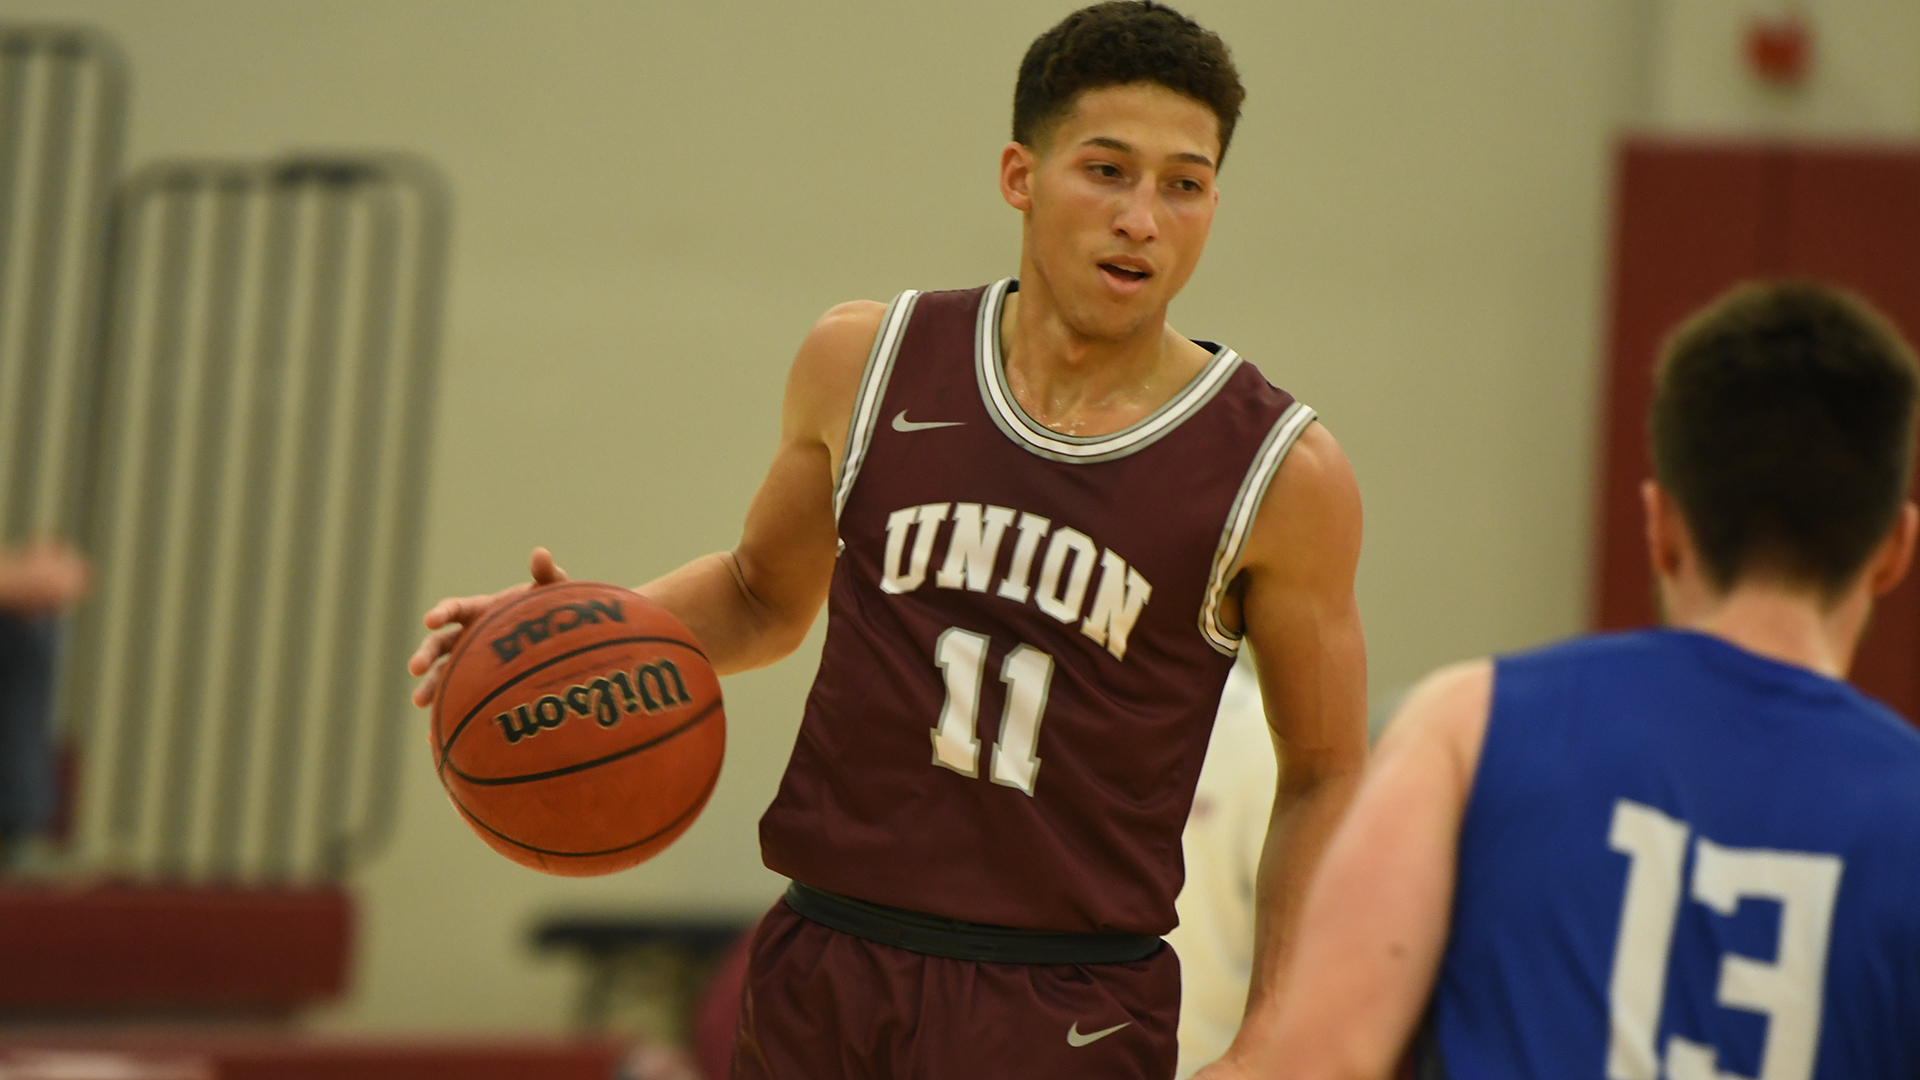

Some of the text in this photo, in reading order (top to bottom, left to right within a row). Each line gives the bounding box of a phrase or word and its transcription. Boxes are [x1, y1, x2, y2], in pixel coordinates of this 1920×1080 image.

[491, 600, 626, 664] NCAA
[880, 502, 1152, 662] UNION
[495, 657, 693, 744] Wilson
[930, 626, 1055, 797] 11
[1606, 798, 1844, 1080] 13
